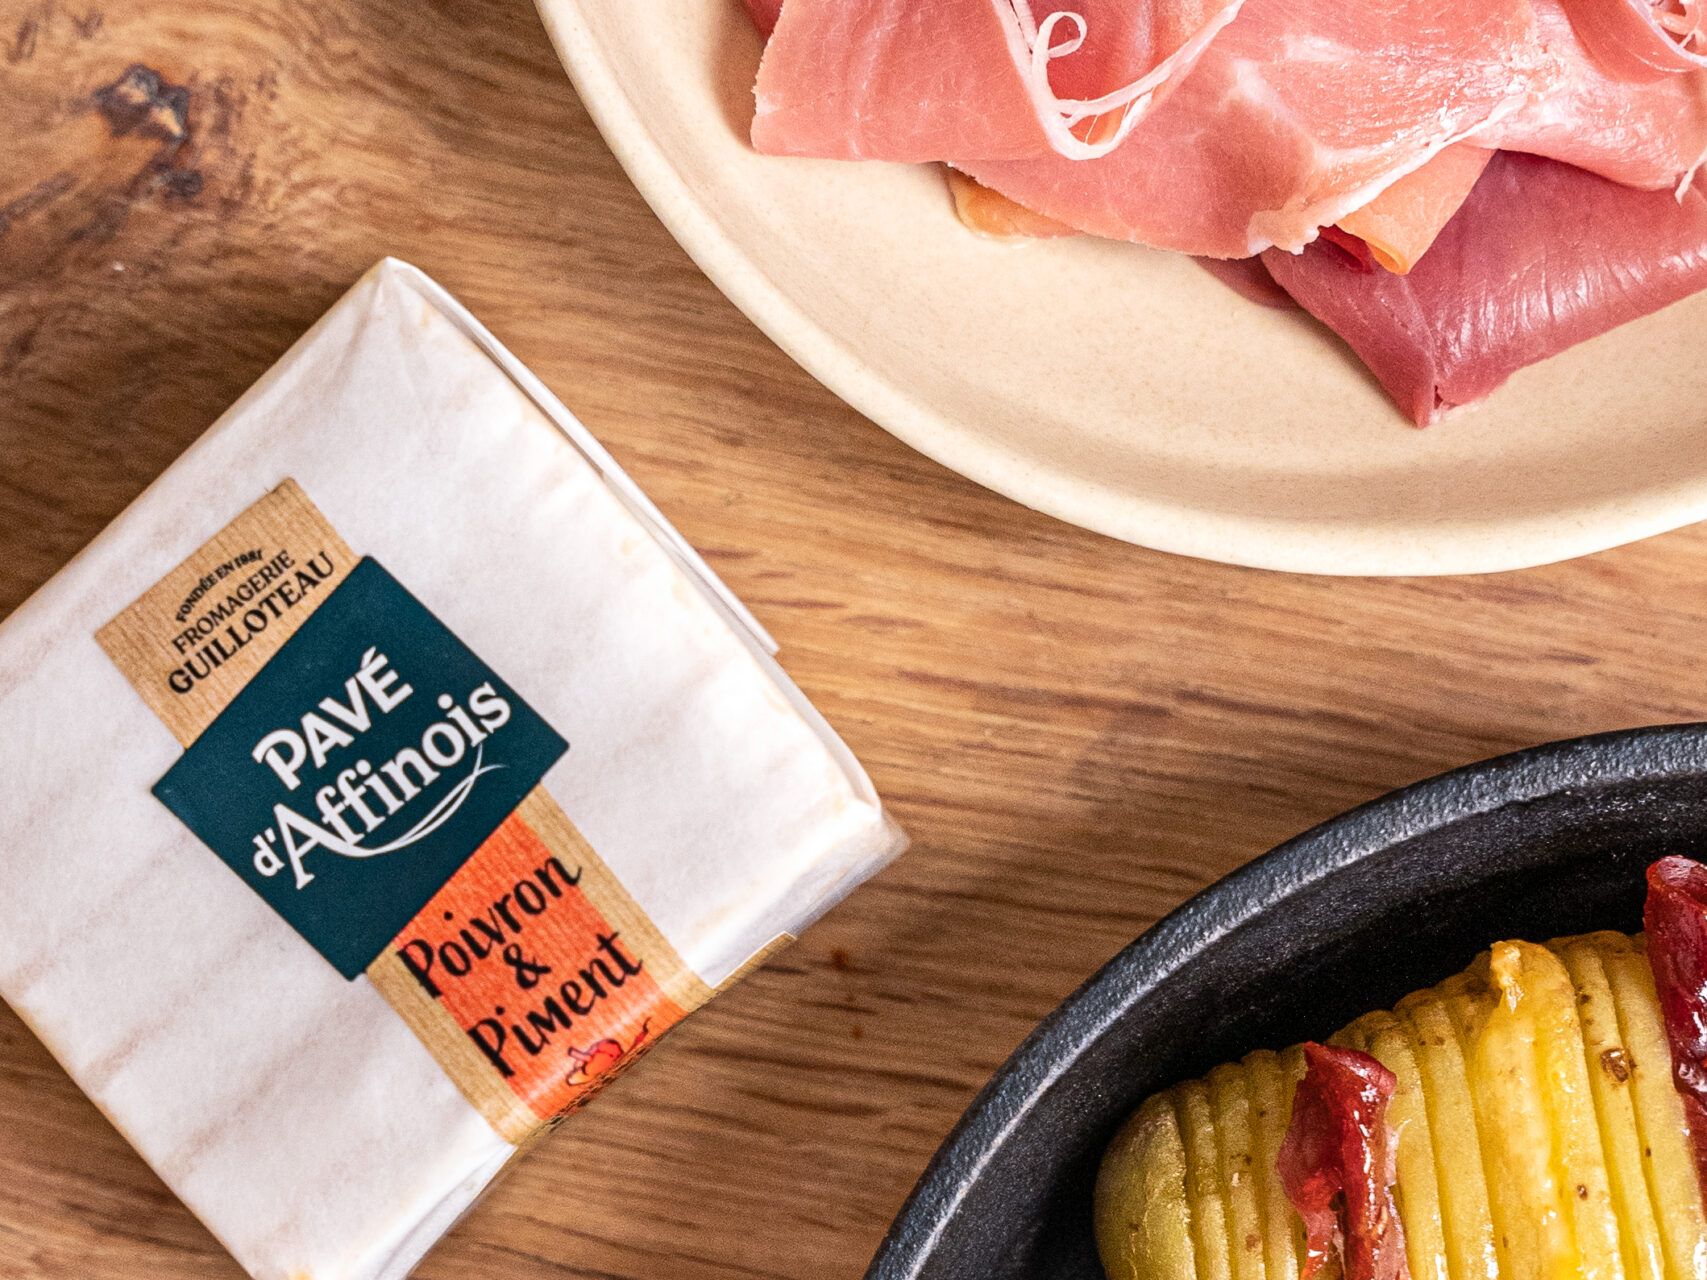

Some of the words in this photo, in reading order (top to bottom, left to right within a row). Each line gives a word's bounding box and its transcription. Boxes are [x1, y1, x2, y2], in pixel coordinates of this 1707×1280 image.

[168, 551, 334, 694] GUILLOTEAU
[171, 549, 295, 655] FROMAGERIE
[175, 573, 218, 623] FONDÉE
[214, 560, 235, 580] EN
[251, 645, 414, 791] PAVÉ
[252, 681, 512, 890] d'Affinois
[396, 856, 583, 998] Poivron
[502, 942, 551, 990] &
[467, 931, 643, 1078] Piment
